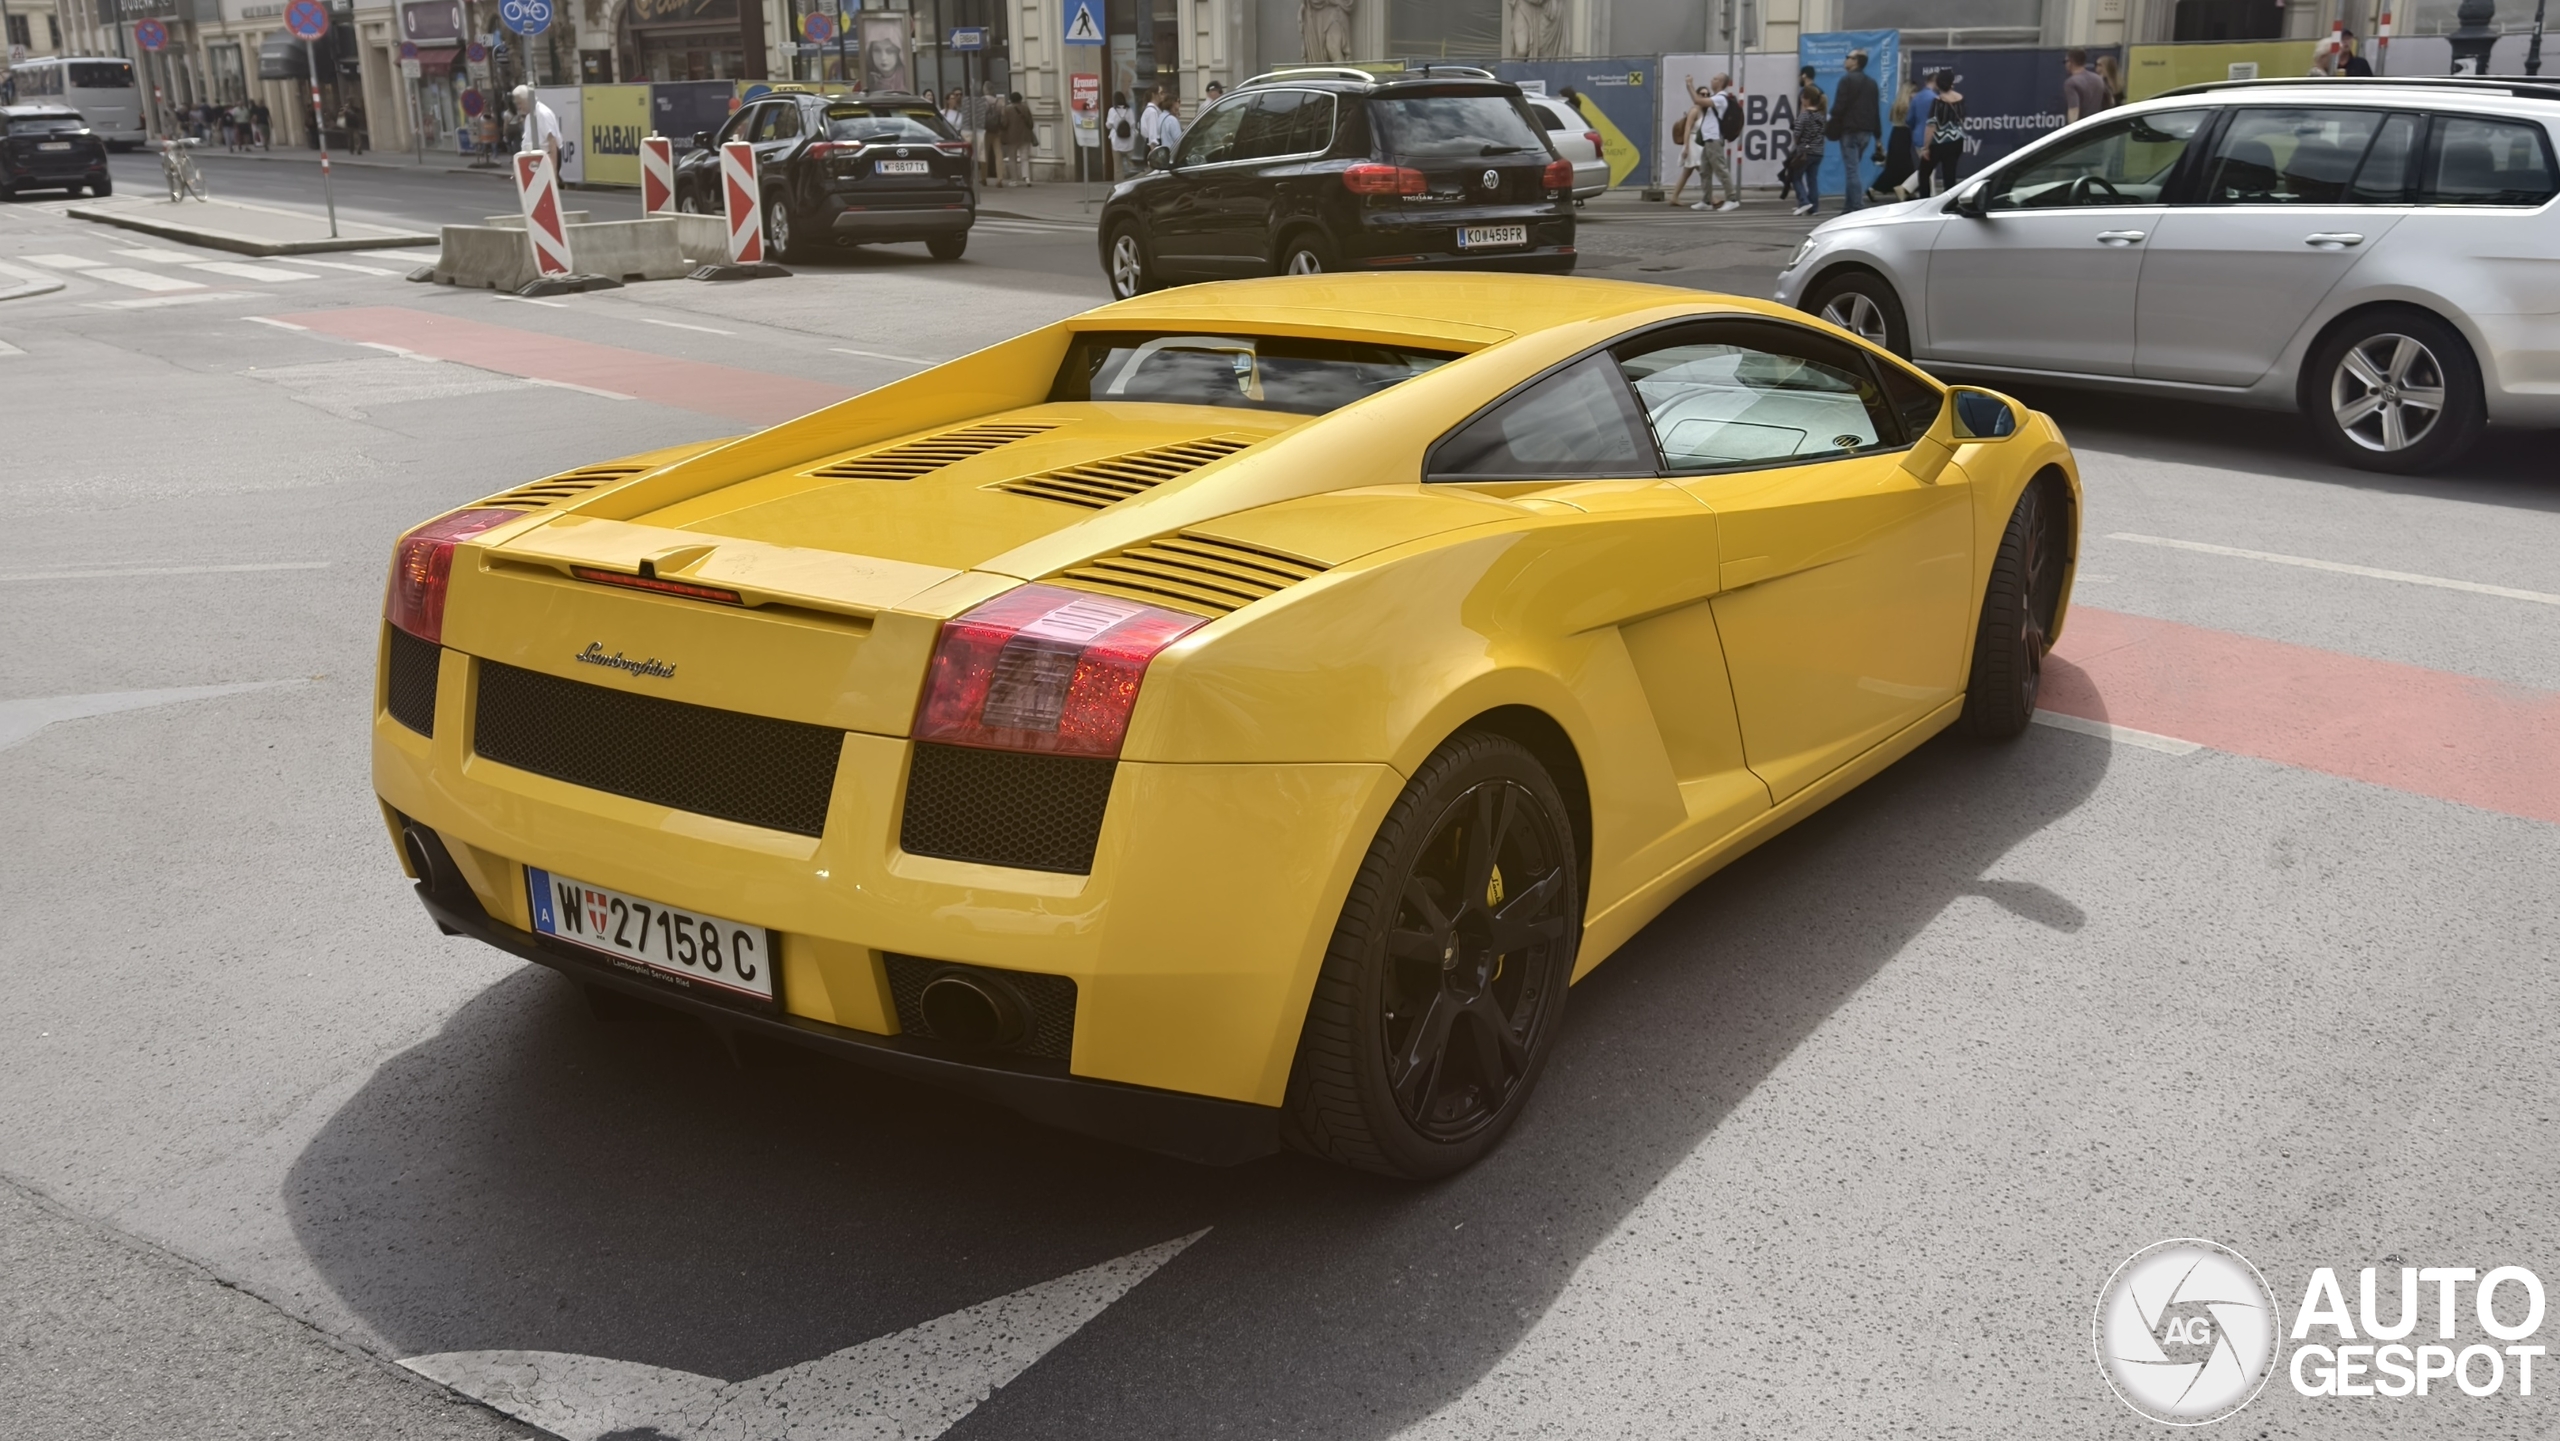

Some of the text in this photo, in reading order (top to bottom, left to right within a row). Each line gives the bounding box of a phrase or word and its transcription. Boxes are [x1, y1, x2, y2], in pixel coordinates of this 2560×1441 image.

[1746, 94, 1795, 126] BA
[1963, 111, 2066, 131] construction
[592, 125, 641, 156] HABAU
[1745, 129, 1792, 161] GR
[1963, 135, 1982, 156] ily
[1467, 229, 1481, 243] KO
[575, 641, 676, 678] Lamborghini
[541, 908, 550, 923] A
[557, 882, 756, 982] W 27158 C
[612, 958, 650, 976] Lamborghini
[651, 969, 674, 984] Service
